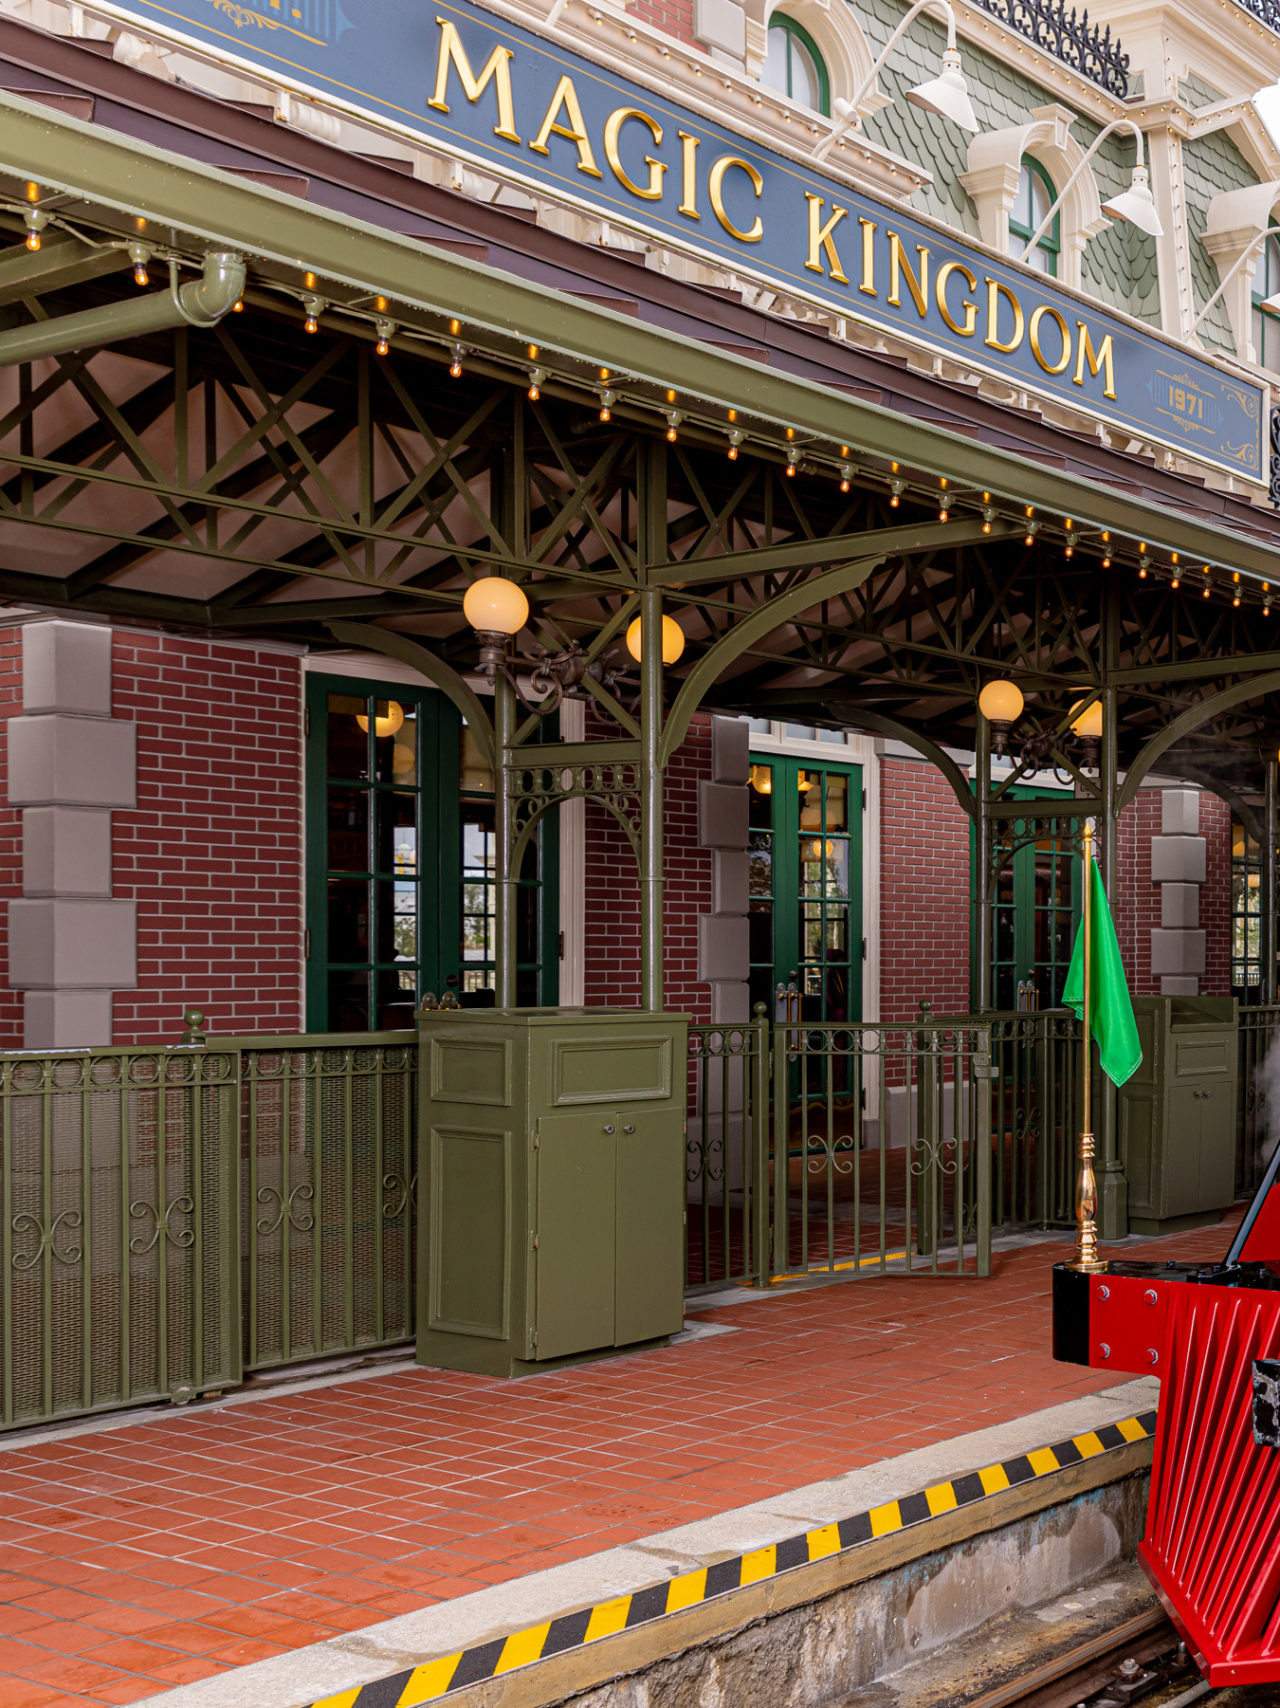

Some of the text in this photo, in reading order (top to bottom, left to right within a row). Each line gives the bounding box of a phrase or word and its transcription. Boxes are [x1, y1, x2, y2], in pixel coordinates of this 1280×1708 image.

[427, 15, 1117, 400] MAGIC KINGDOM
[1169, 385, 1203, 419] 1971
